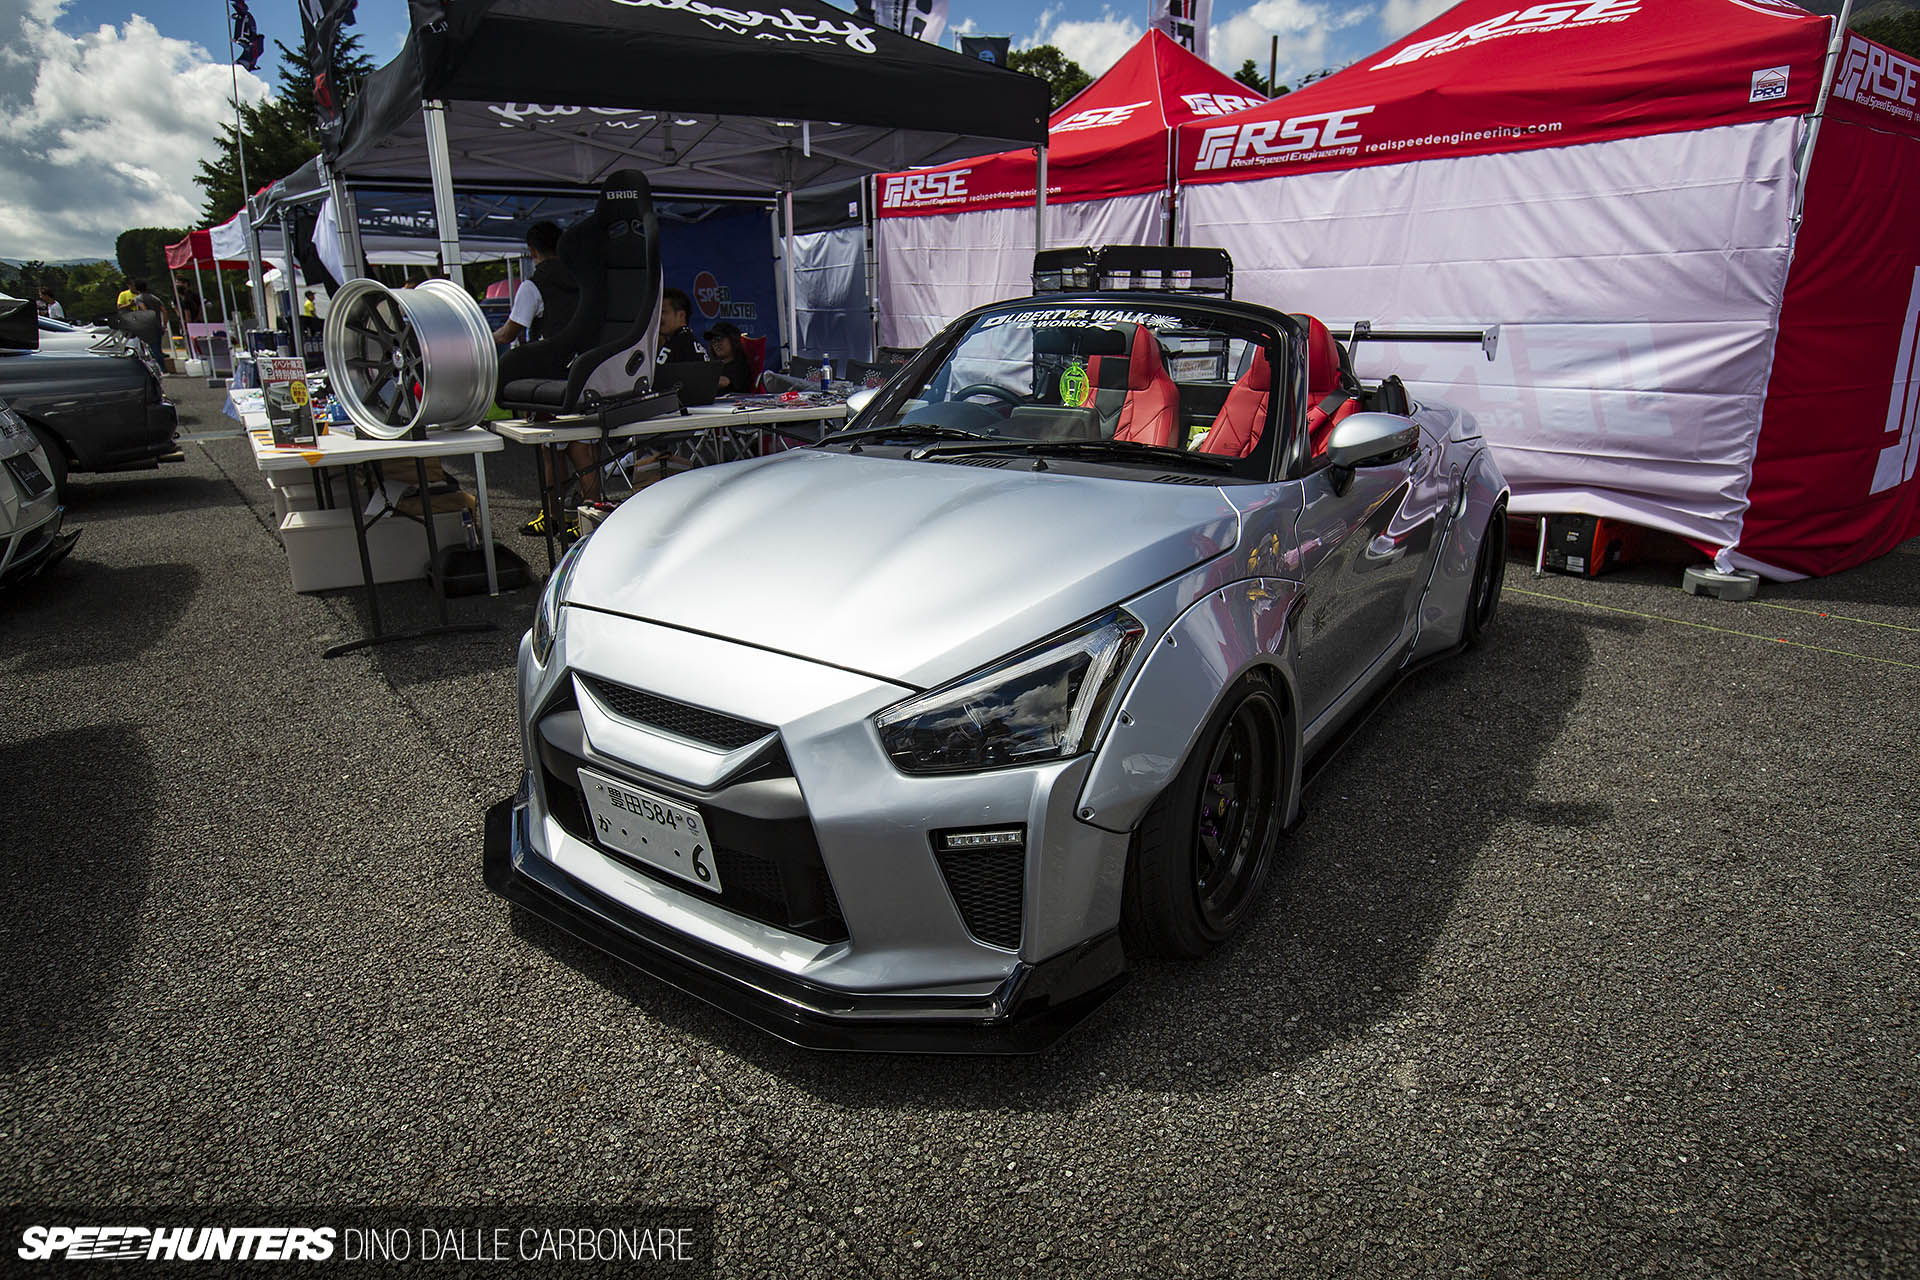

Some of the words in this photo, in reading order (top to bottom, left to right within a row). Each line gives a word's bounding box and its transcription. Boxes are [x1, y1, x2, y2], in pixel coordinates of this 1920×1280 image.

[700, 18, 837, 45] WALK
[1753, 86, 1785, 98] PRO
[1233, 105, 1376, 157] RSE
[1365, 121, 1562, 152] realspeedengineering.com
[1231, 157, 1254, 168] Real
[1255, 153, 1289, 166] Speed
[1289, 145, 1358, 161] Engineering
[903, 168, 972, 200] RSE
[606, 190, 639, 200] BRIDE
[698, 286, 730, 303] SPEED
[720, 303, 757, 318] MASTER
[1004, 309, 1075, 323] LIBERTY
[1091, 309, 1151, 324] WALK
